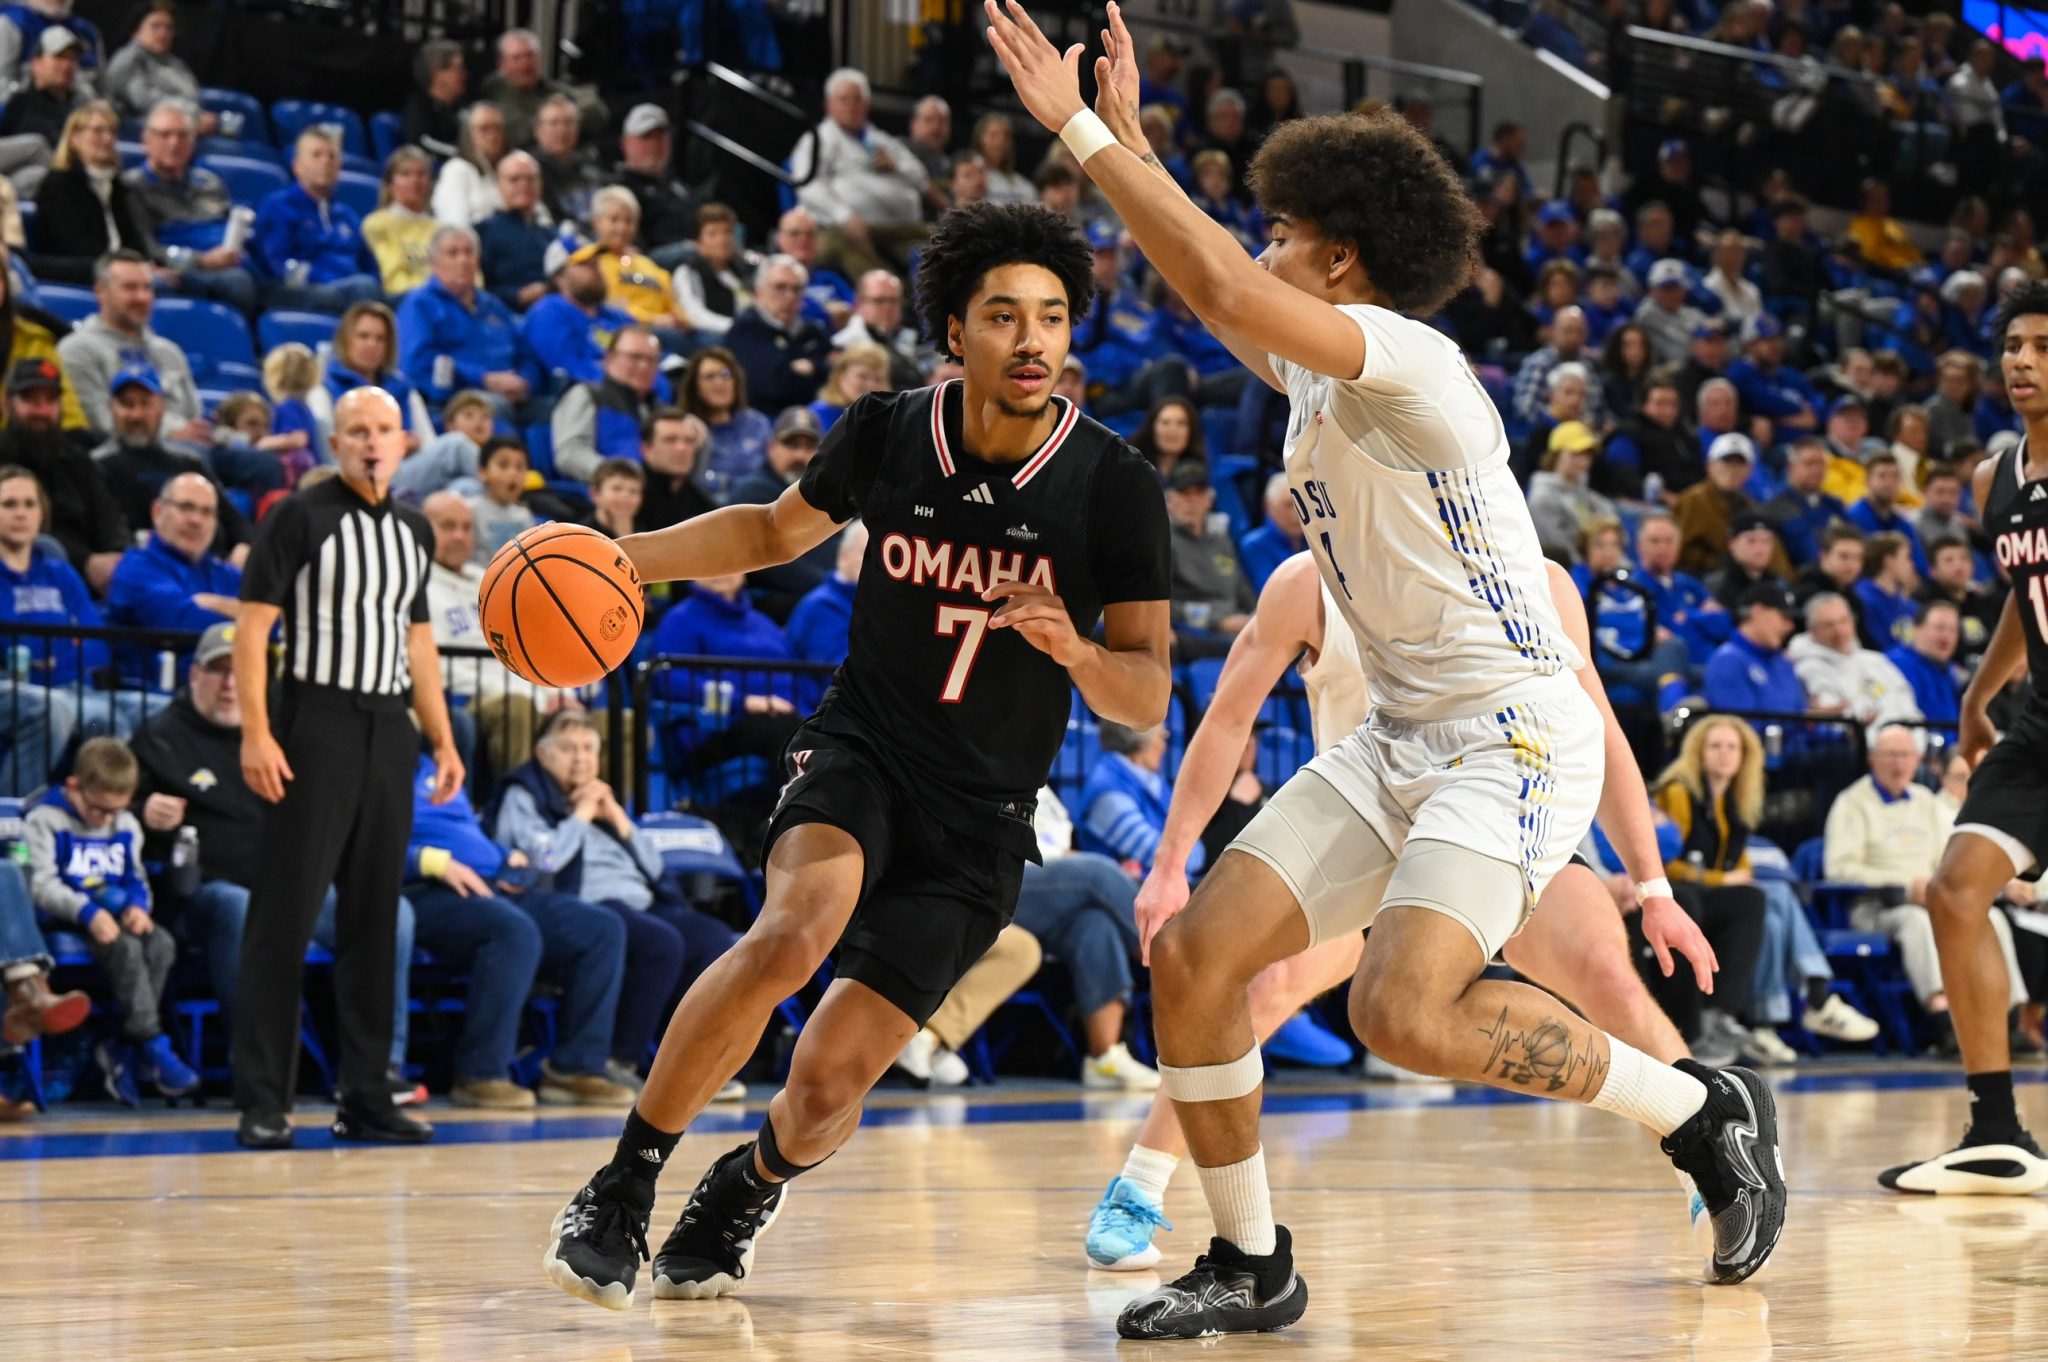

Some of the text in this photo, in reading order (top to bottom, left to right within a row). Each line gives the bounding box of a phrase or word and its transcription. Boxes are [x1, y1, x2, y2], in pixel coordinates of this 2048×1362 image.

[914, 505, 934, 518] HH
[1005, 527, 1038, 540] SUMMIT
[881, 532, 1057, 596] OMAHA
[934, 603, 992, 703] 7
